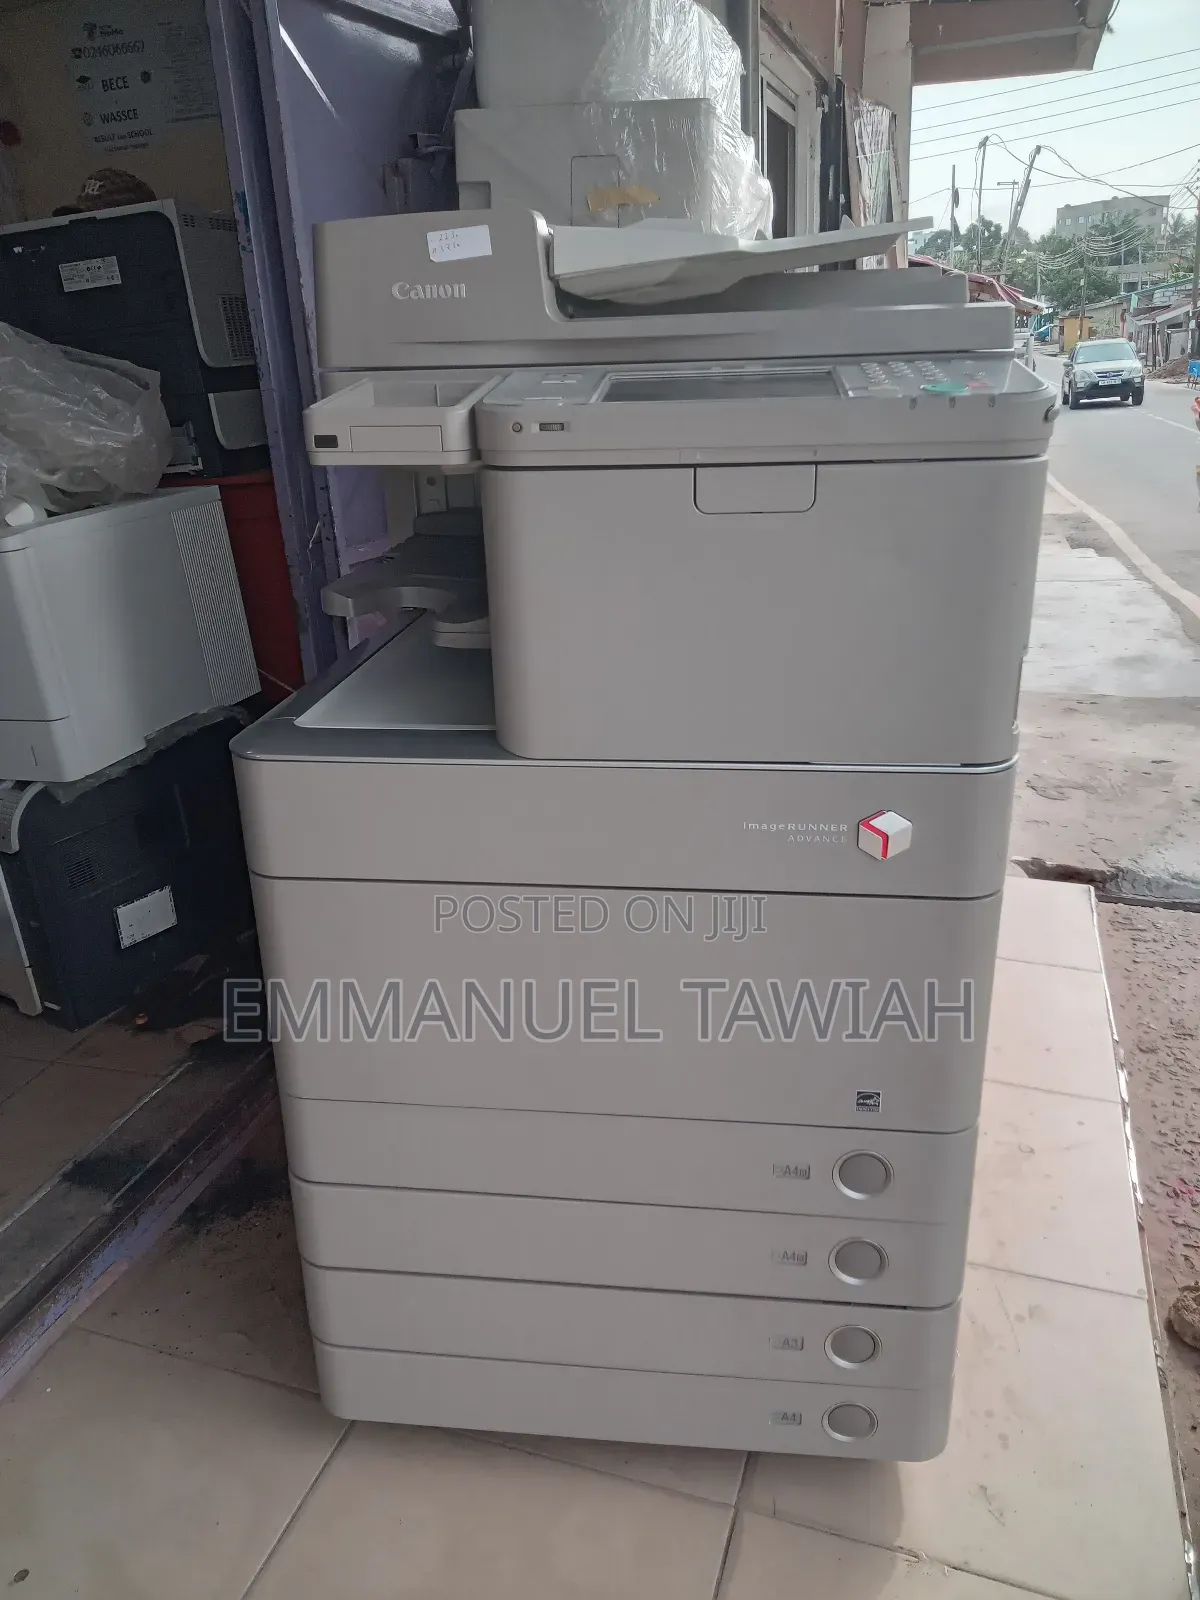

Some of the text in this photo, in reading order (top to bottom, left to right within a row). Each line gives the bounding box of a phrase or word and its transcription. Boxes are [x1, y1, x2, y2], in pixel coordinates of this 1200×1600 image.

[101, 76, 130, 92] BECE
[100, 109, 139, 124] WASSCE
[127, 128, 153, 139] SCHOOL
[391, 281, 467, 300] Canon
[742, 821, 849, 832] imageRUNNER
[786, 834, 847, 844] ADVANCE
[781, 1411, 797, 1422] A4
